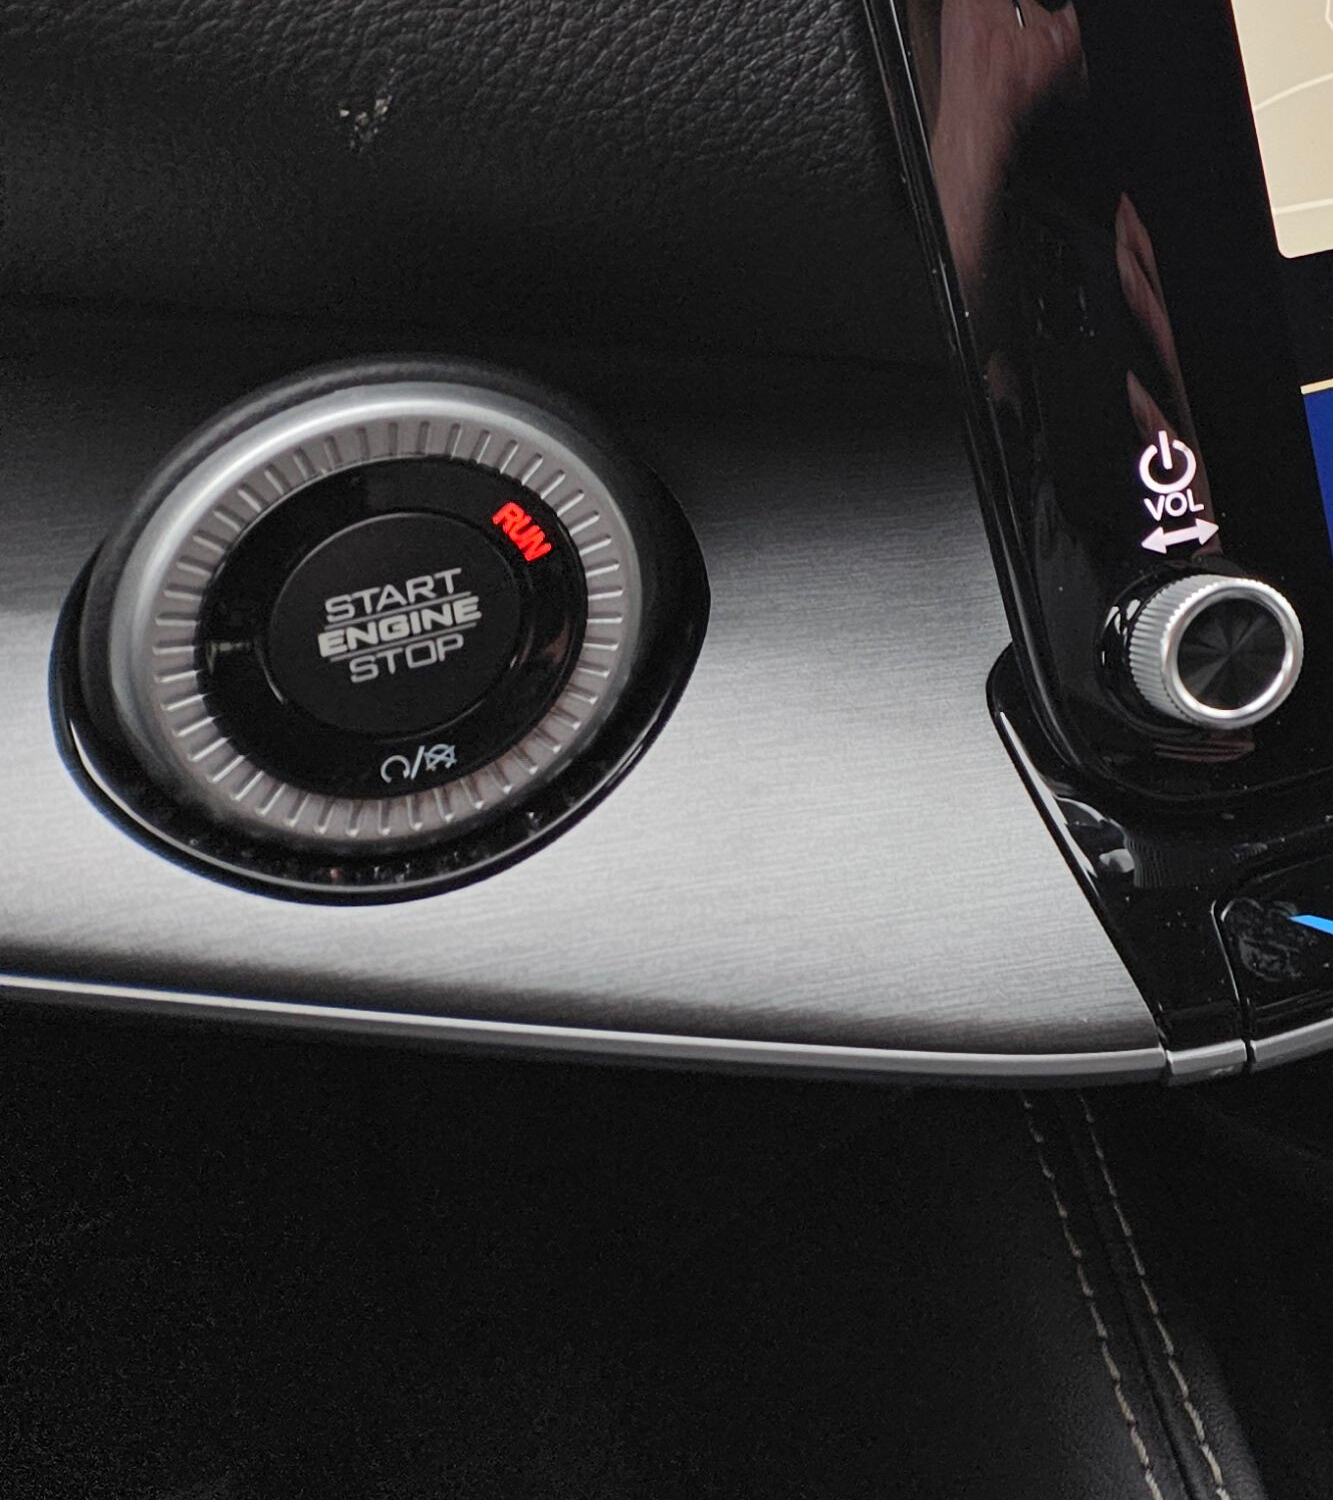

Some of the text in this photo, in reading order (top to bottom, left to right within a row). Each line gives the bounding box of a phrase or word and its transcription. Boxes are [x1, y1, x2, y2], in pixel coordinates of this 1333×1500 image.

[492, 501, 552, 562] RUN
[1144, 488, 1204, 522] VOL
[324, 567, 463, 623] START
[317, 596, 482, 658] ENGINE
[349, 633, 464, 684] STOP
